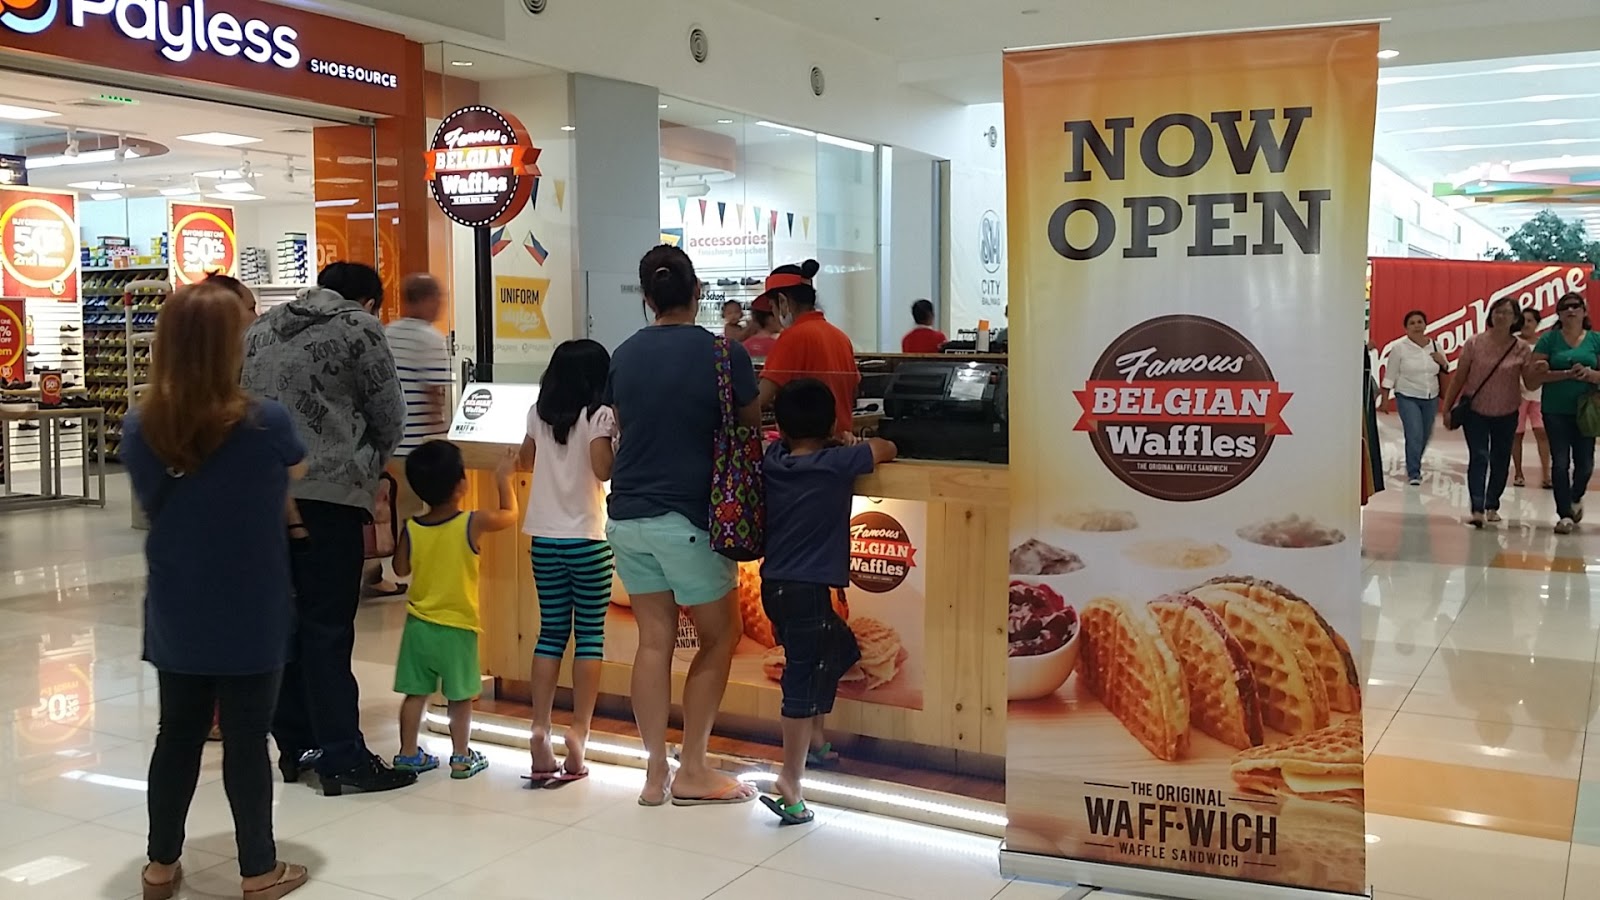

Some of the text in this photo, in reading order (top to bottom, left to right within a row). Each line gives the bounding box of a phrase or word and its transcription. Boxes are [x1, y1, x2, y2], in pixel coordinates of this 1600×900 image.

[310, 58, 397, 88] SHOESOURCE
[444, 127, 501, 150] Famous
[1064, 106, 1313, 182] NOW
[435, 148, 514, 170] BELGIAN
[441, 172, 508, 195] Waffles
[1048, 189, 1331, 260] OPEN
[689, 231, 767, 247] accessories
[500, 287, 540, 305] UNIFORM
[706, 290, 726, 301] School
[981, 279, 1001, 295] CITY
[1115, 347, 1244, 384] Famous
[1092, 387, 1271, 416] BELGIAN
[1105, 425, 1256, 458] Waffles
[1136, 462, 1228, 473] THE ORIGINAL WAFFLE SANDWICH
[850, 523, 900, 540] Famous
[850, 540, 909, 558] ELGIAN
[850, 557, 904, 576] Waffles
[1130, 781, 1226, 807] THE ORIGINAL
[1119, 841, 1239, 868] WAFFLE SANDWICH
